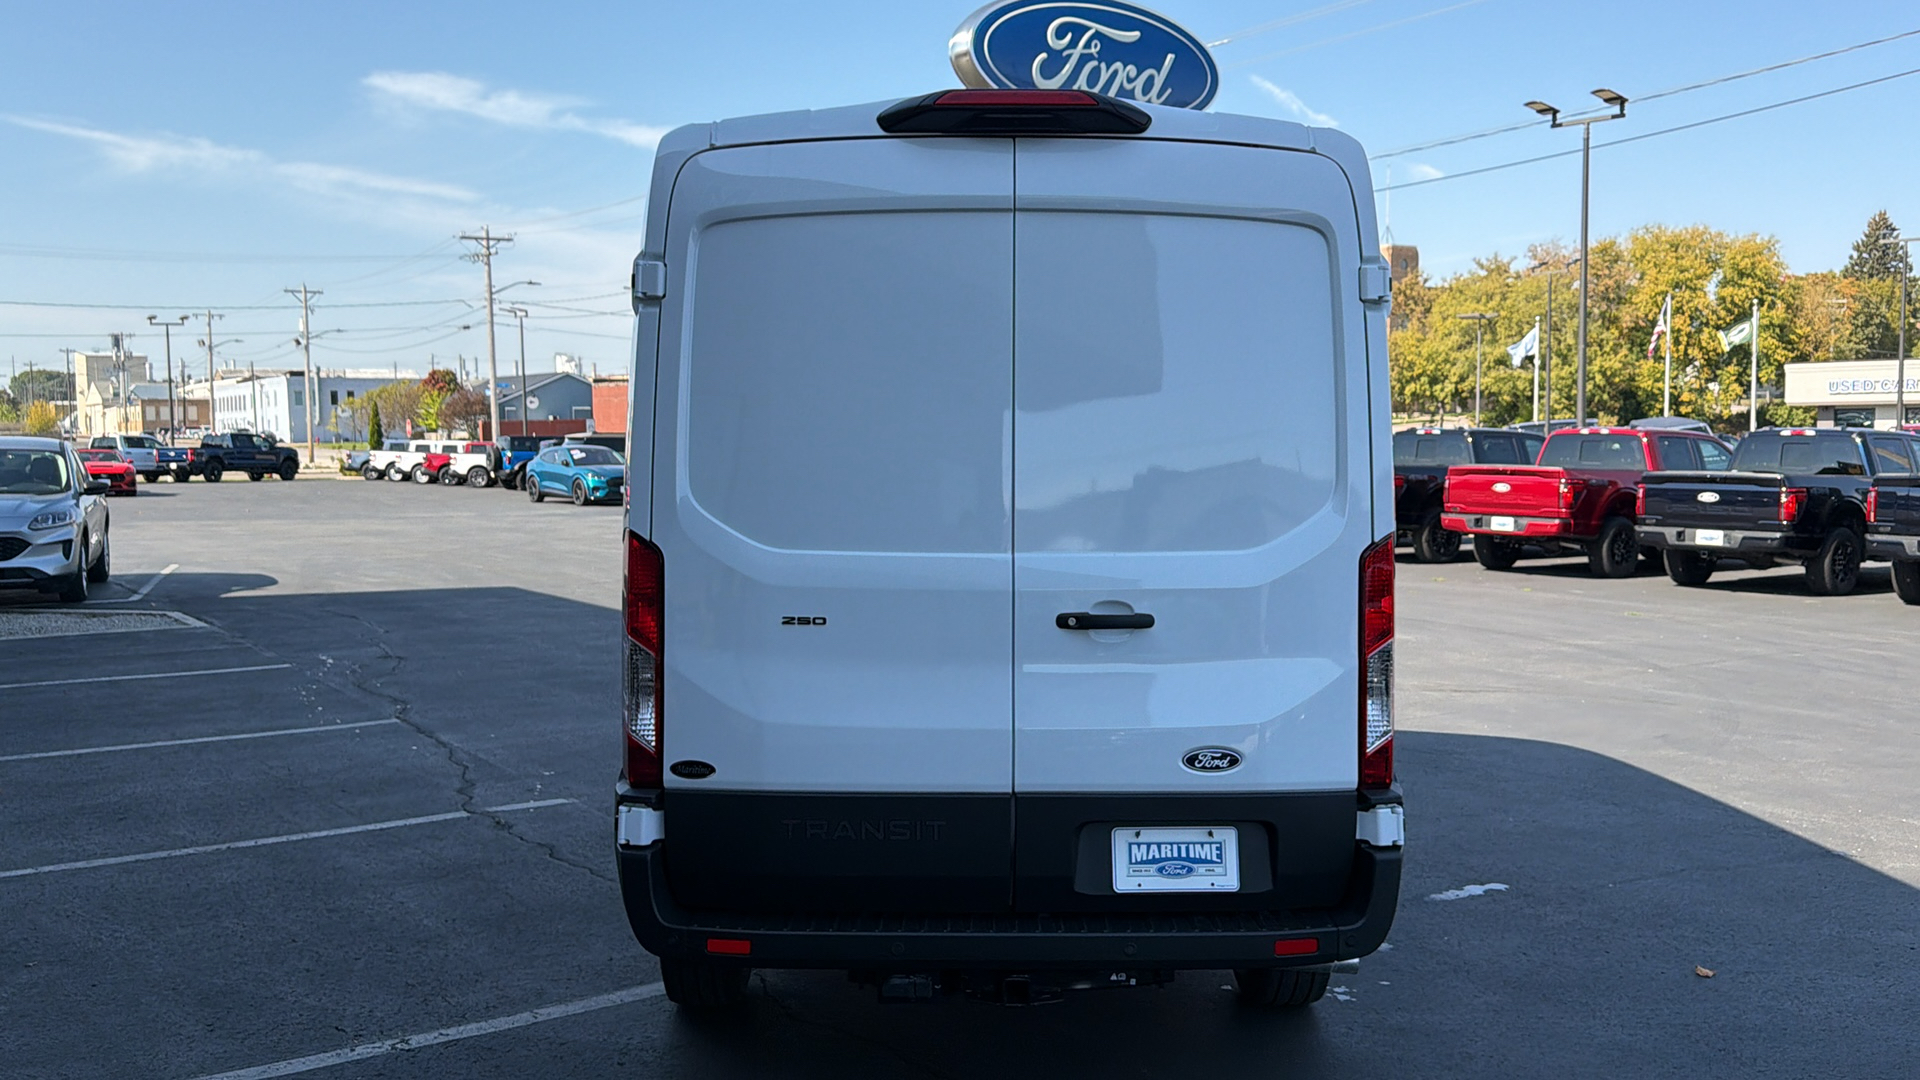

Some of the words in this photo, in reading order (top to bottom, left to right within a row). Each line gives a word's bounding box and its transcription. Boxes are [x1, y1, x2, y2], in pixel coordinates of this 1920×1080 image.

[1032, 16, 1176, 104] Ford
[1828, 380, 1874, 392] USED
[781, 616, 827, 626] 250
[1194, 752, 1231, 768] Ford
[780, 819, 947, 841] TRANSIT
[1131, 843, 1222, 864] MARITIME
[1162, 864, 1189, 875] Ford
